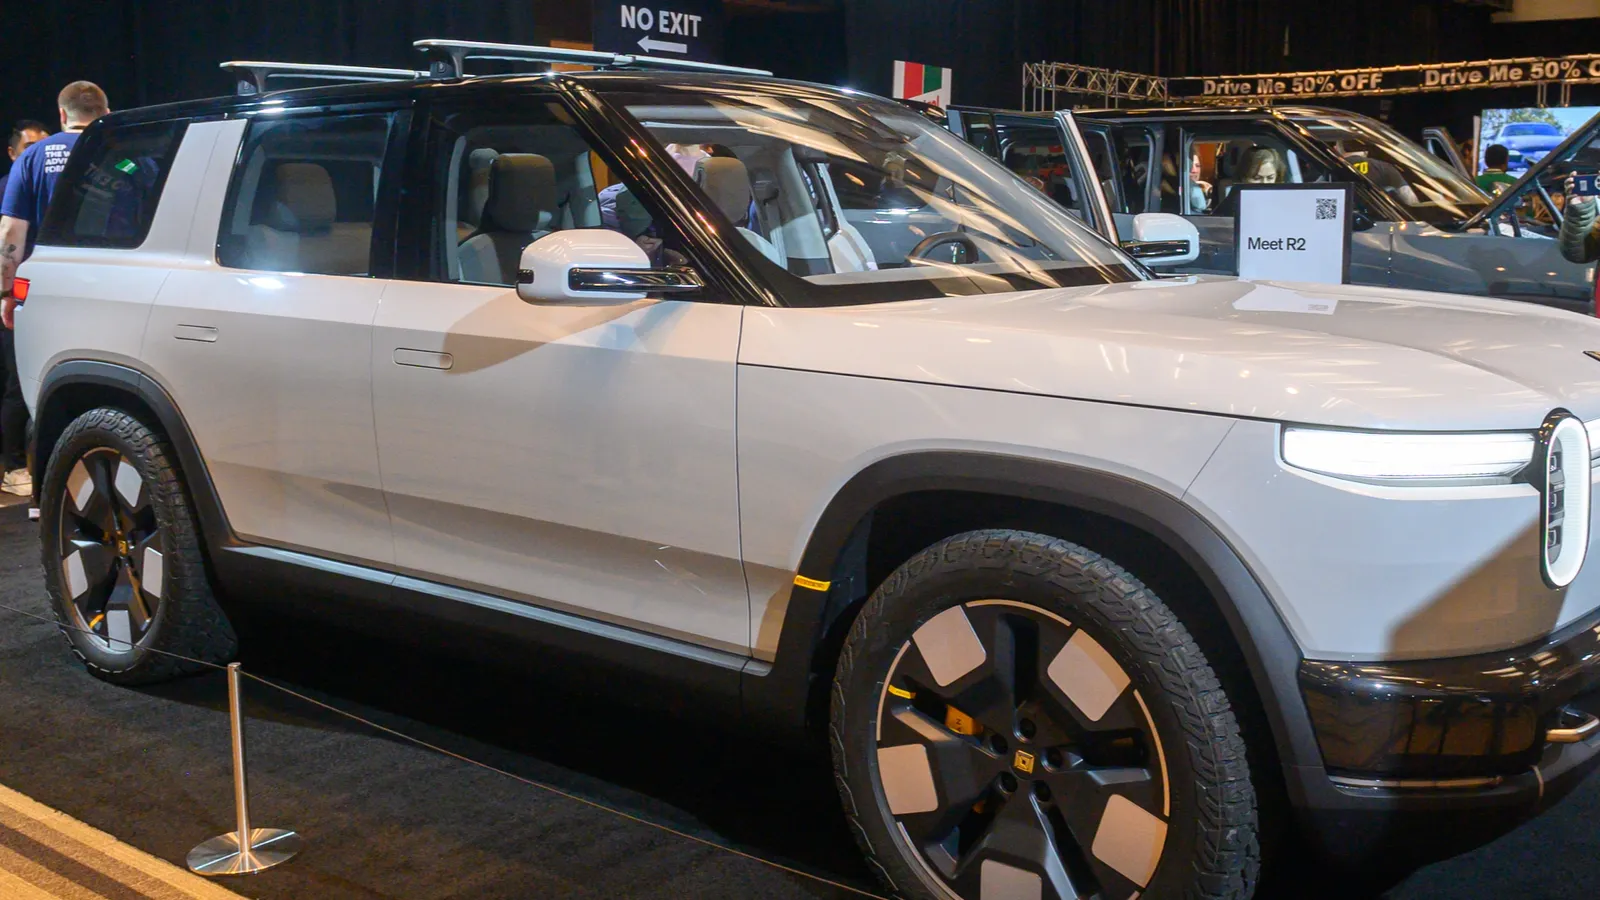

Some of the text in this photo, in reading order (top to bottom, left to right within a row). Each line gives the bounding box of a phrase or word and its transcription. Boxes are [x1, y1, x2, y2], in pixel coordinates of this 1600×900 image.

[621, 5, 702, 37] NO EXIT
[1203, 73, 1383, 95] Drive Me 50% OFF
[1425, 68, 1483, 86] Drive
[1489, 65, 1523, 82] Me
[1530, 60, 1581, 79] 50%
[1247, 237, 1306, 251] Meet R2
